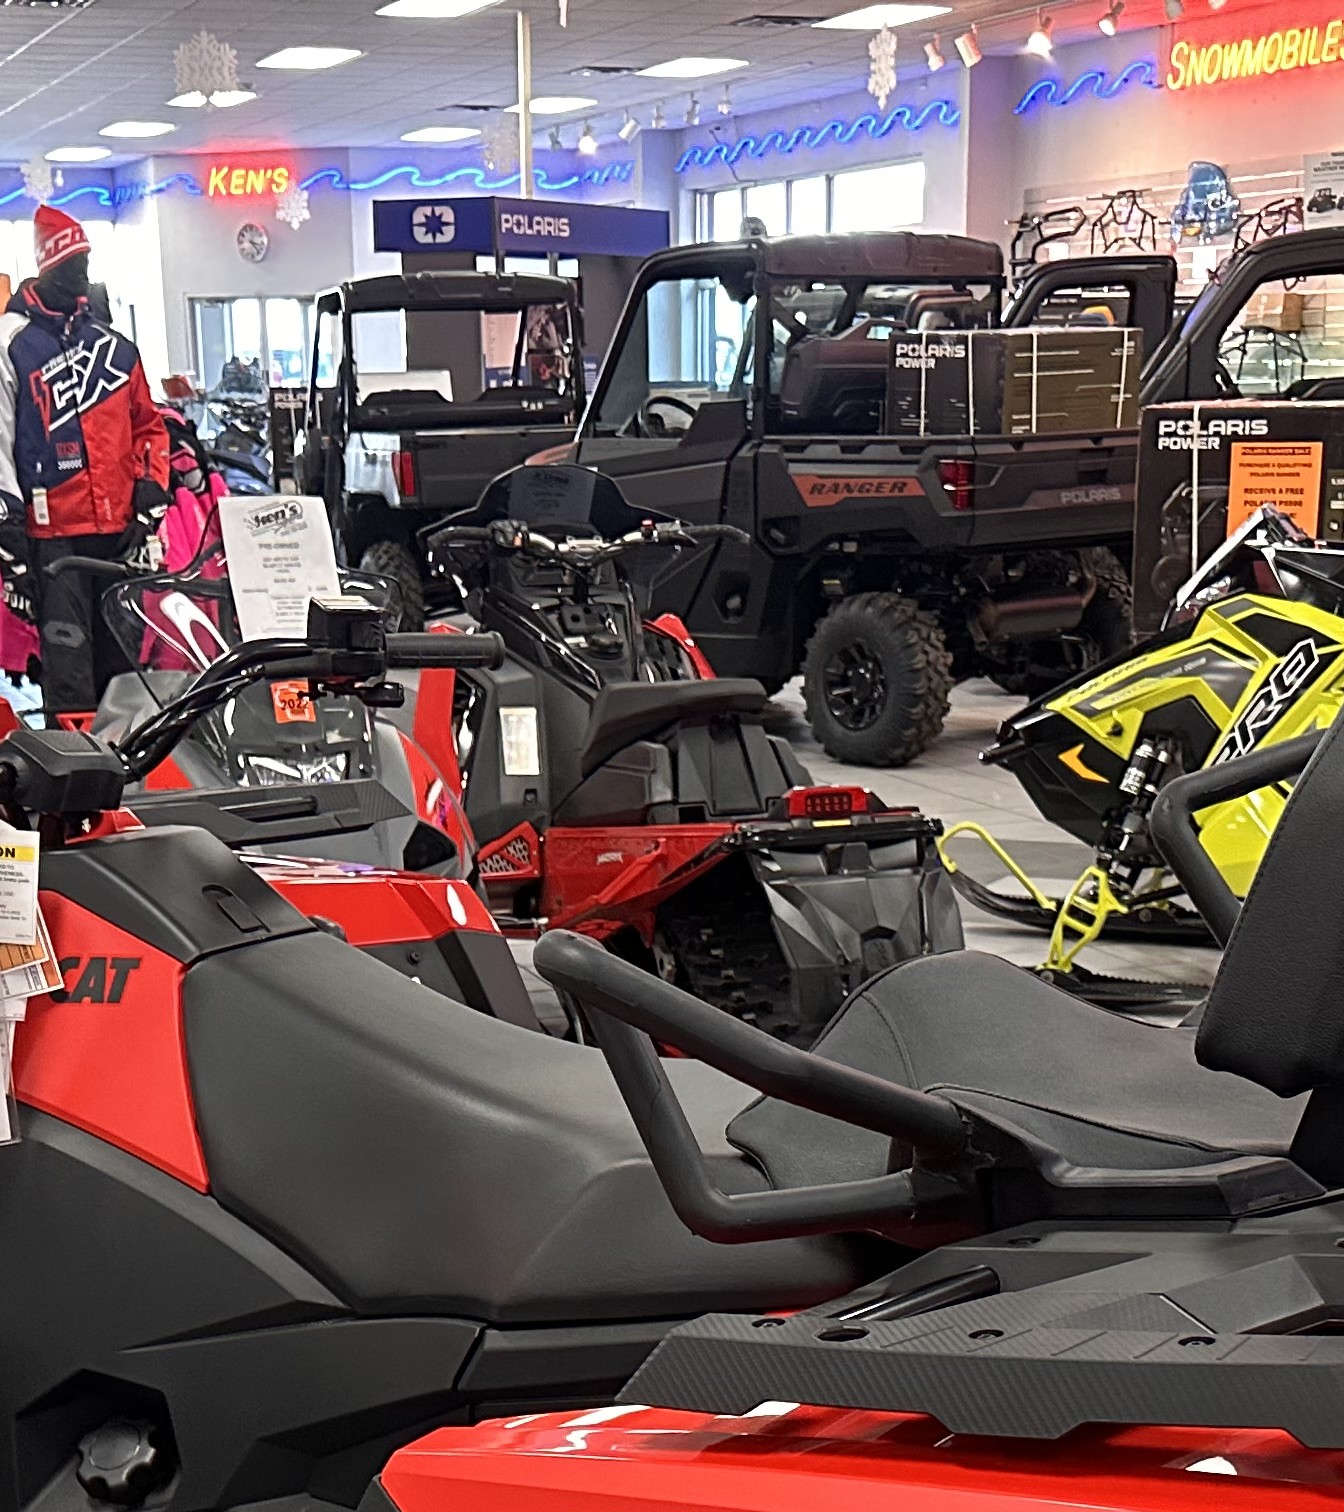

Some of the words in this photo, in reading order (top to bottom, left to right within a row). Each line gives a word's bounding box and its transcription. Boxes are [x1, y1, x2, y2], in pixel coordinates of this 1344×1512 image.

[208, 165, 289, 197] KEN'S
[500, 213, 570, 237] POLARIS
[896, 343, 965, 358] POLARIS
[1158, 419, 1269, 435] POLARIS
[1158, 437, 1220, 450] POWER
[809, 482, 908, 495] RANGER
[1060, 488, 1120, 504] POLARIS
[49, 956, 142, 1004] CAT
